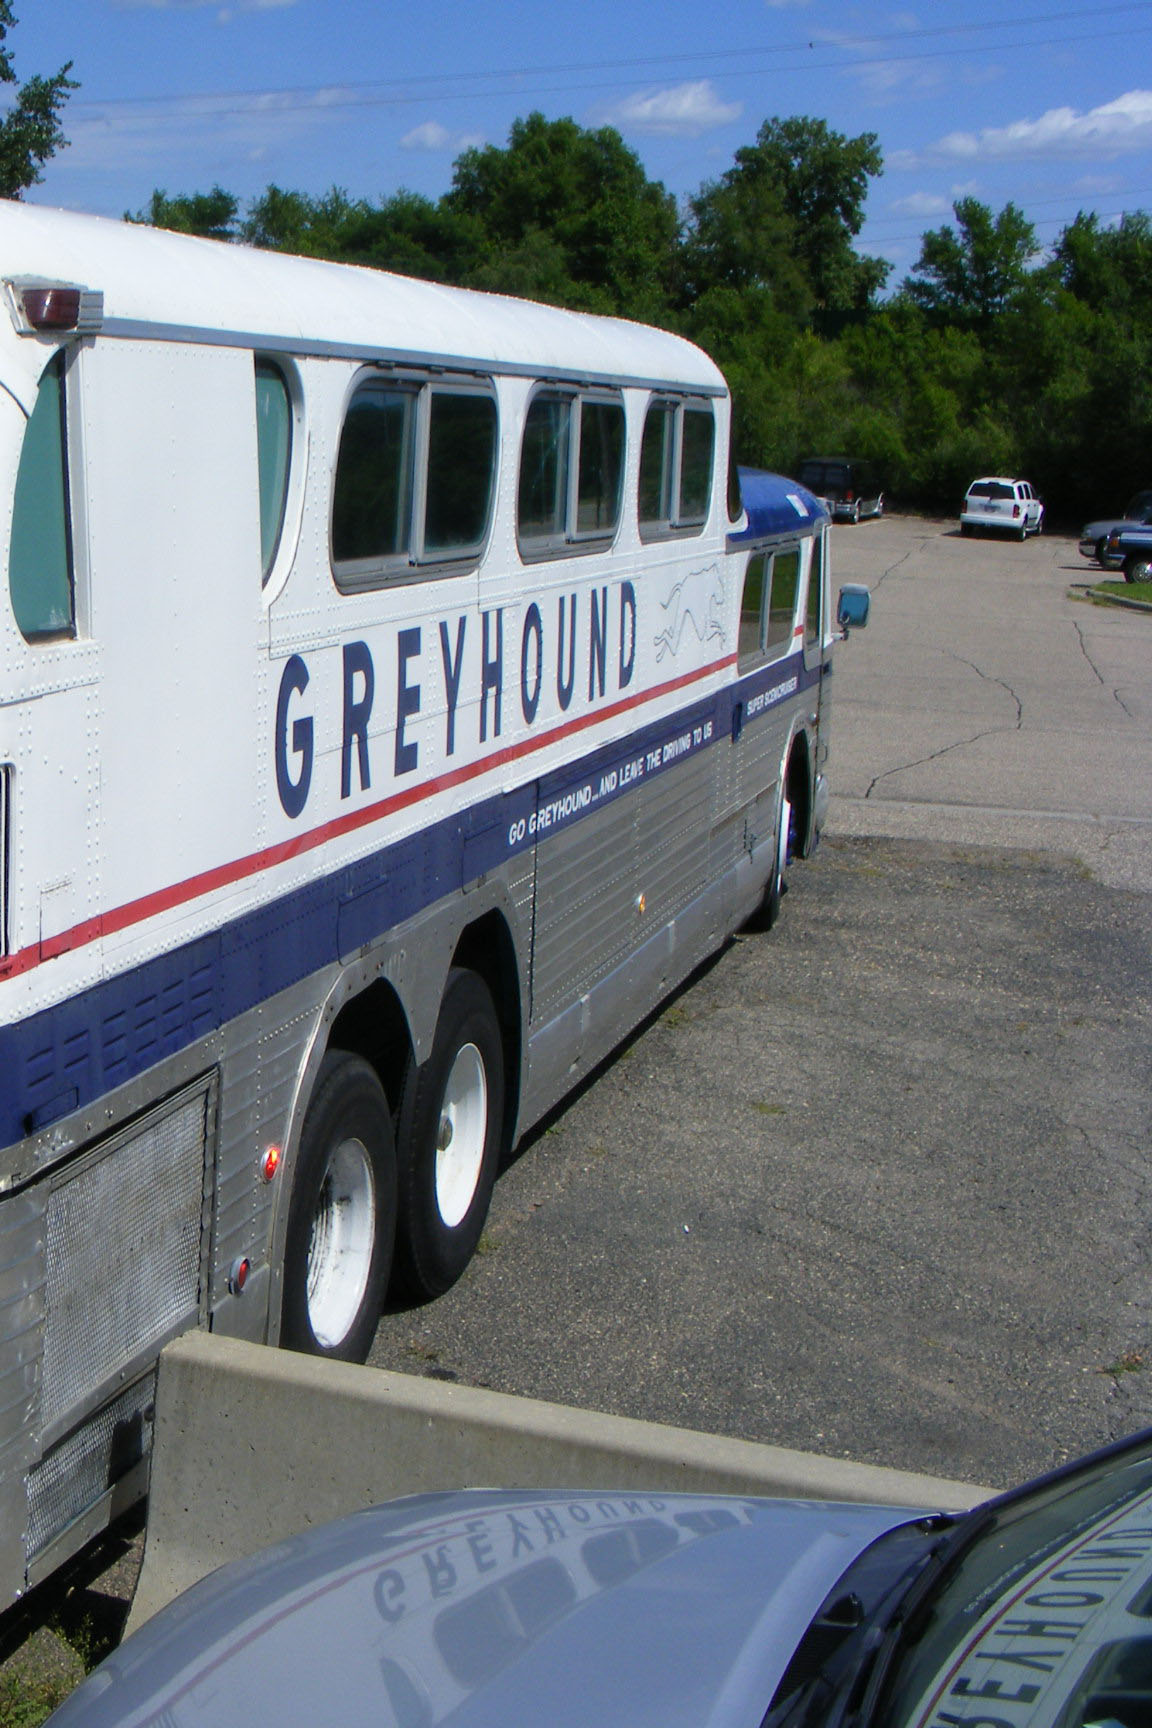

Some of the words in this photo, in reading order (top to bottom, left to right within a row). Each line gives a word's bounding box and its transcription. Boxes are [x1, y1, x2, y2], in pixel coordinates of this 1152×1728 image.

[275, 581, 637, 819] GREYHOUND
[508, 818, 526, 846] GO
[619, 757, 644, 787] LEAVE
[646, 748, 662, 771] THE
[663, 732, 691, 763] DRIVING
[693, 727, 702, 746] TO
[703, 721, 713, 740] US
